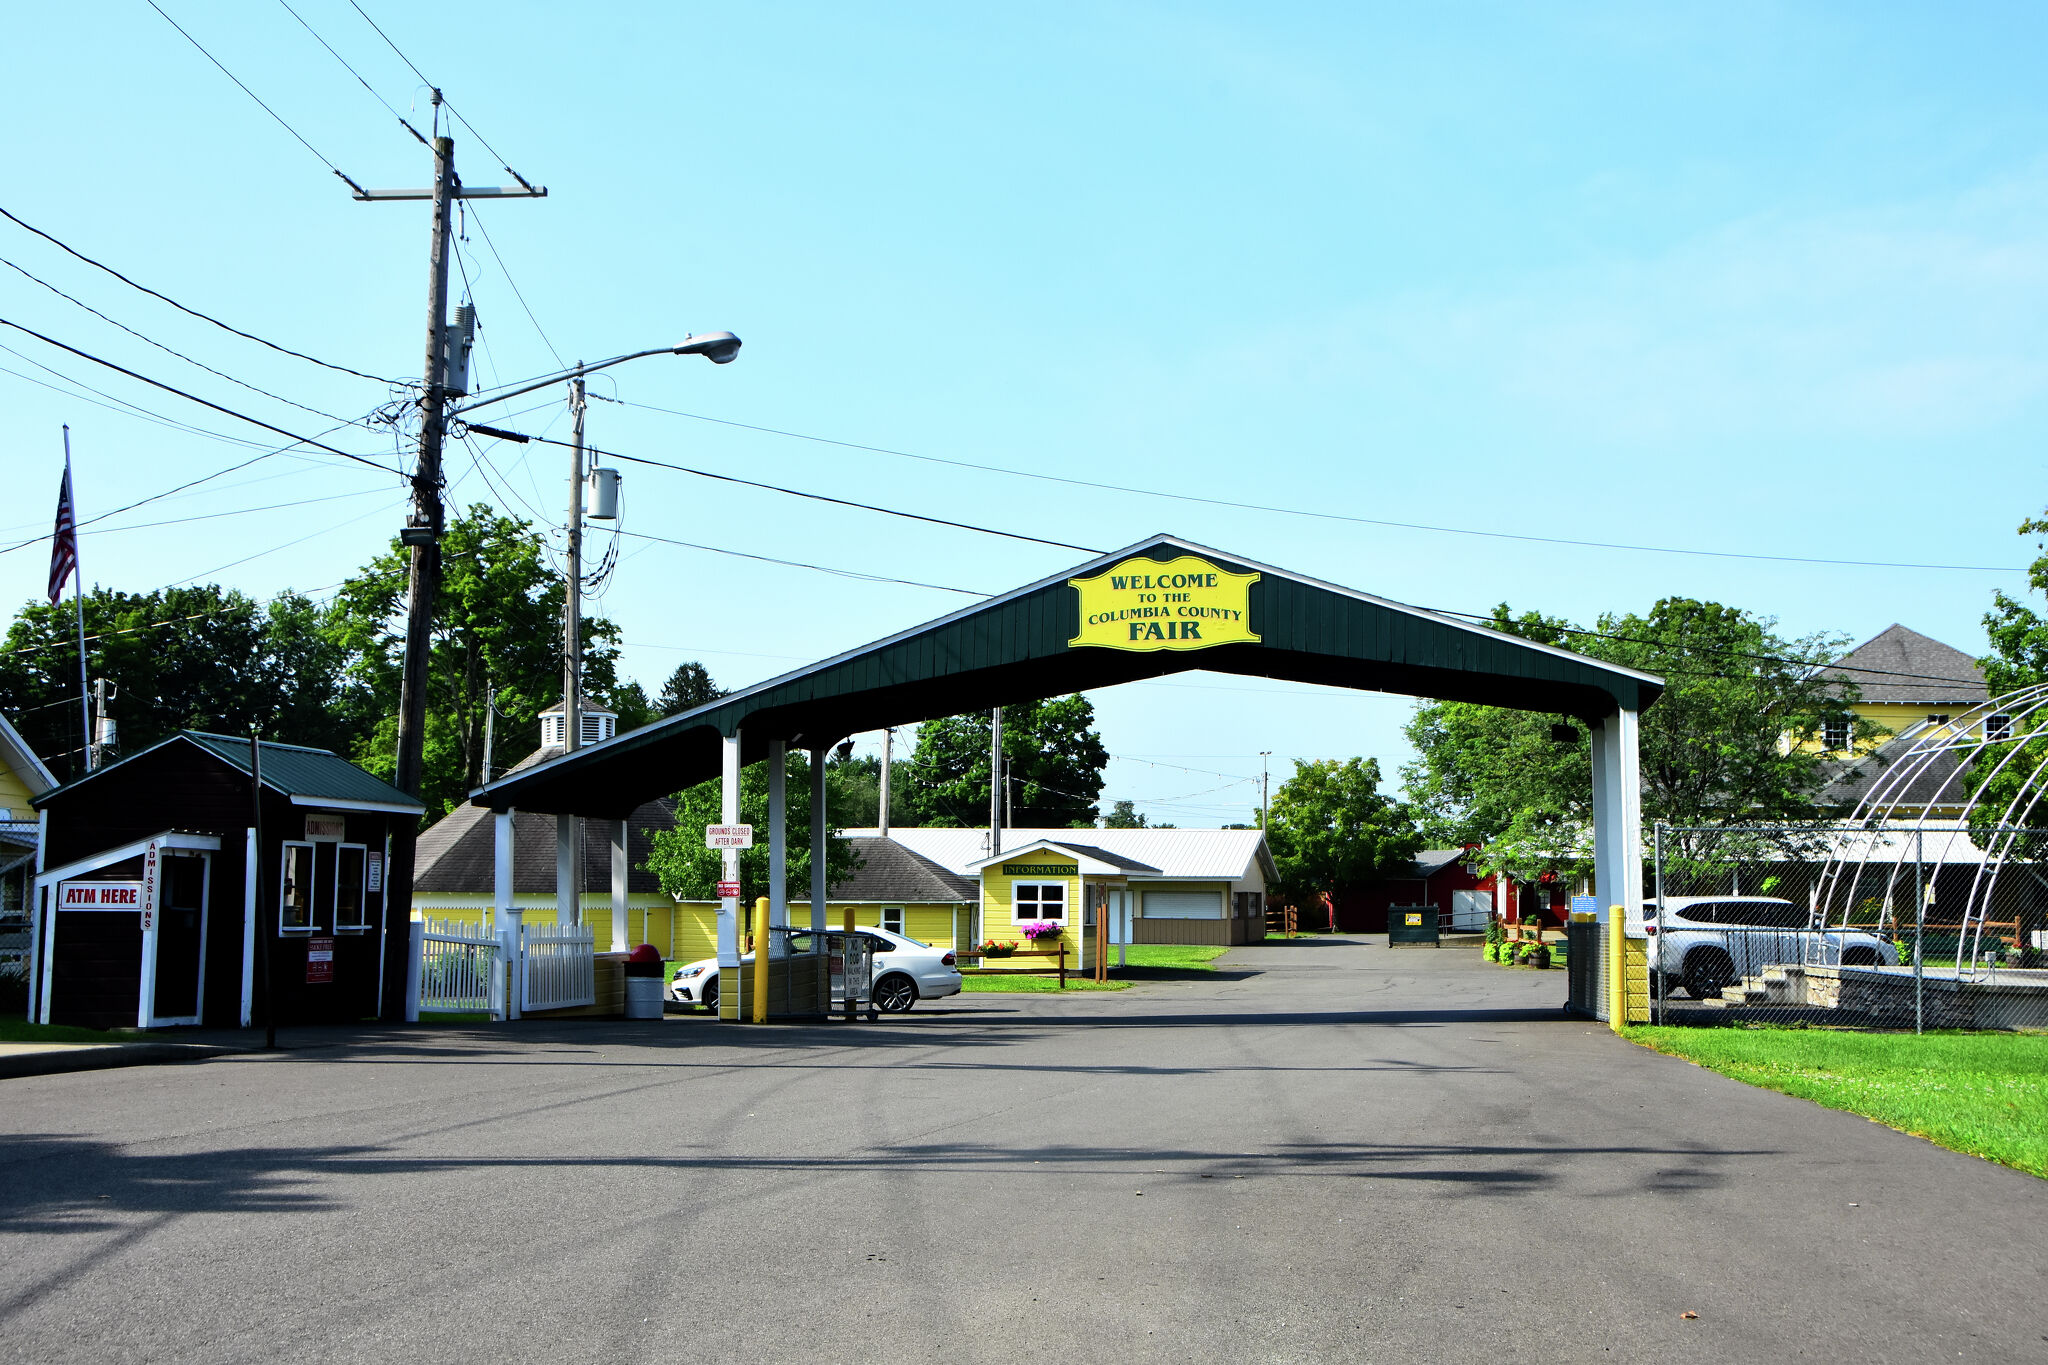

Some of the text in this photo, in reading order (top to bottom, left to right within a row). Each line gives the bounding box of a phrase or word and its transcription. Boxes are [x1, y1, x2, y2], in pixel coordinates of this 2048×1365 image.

[1111, 573, 1218, 590] WELCOME
[1138, 593, 1191, 603] TO THE
[1088, 606, 1242, 625] COLUMBIA COUNTY
[1128, 621, 1202, 641] FAIR
[306, 820, 344, 837] ADMISSIONS
[709, 827, 750, 836] GROUNDS CLOSED
[715, 837, 744, 846] AFTER DARK
[1005, 866, 1076, 874] INFORMATION
[144, 842, 156, 928] ADMISSIONS
[65, 888, 137, 904] ATM HERE
[850, 939, 858, 950] NO
[850, 953, 859, 965] DOG
